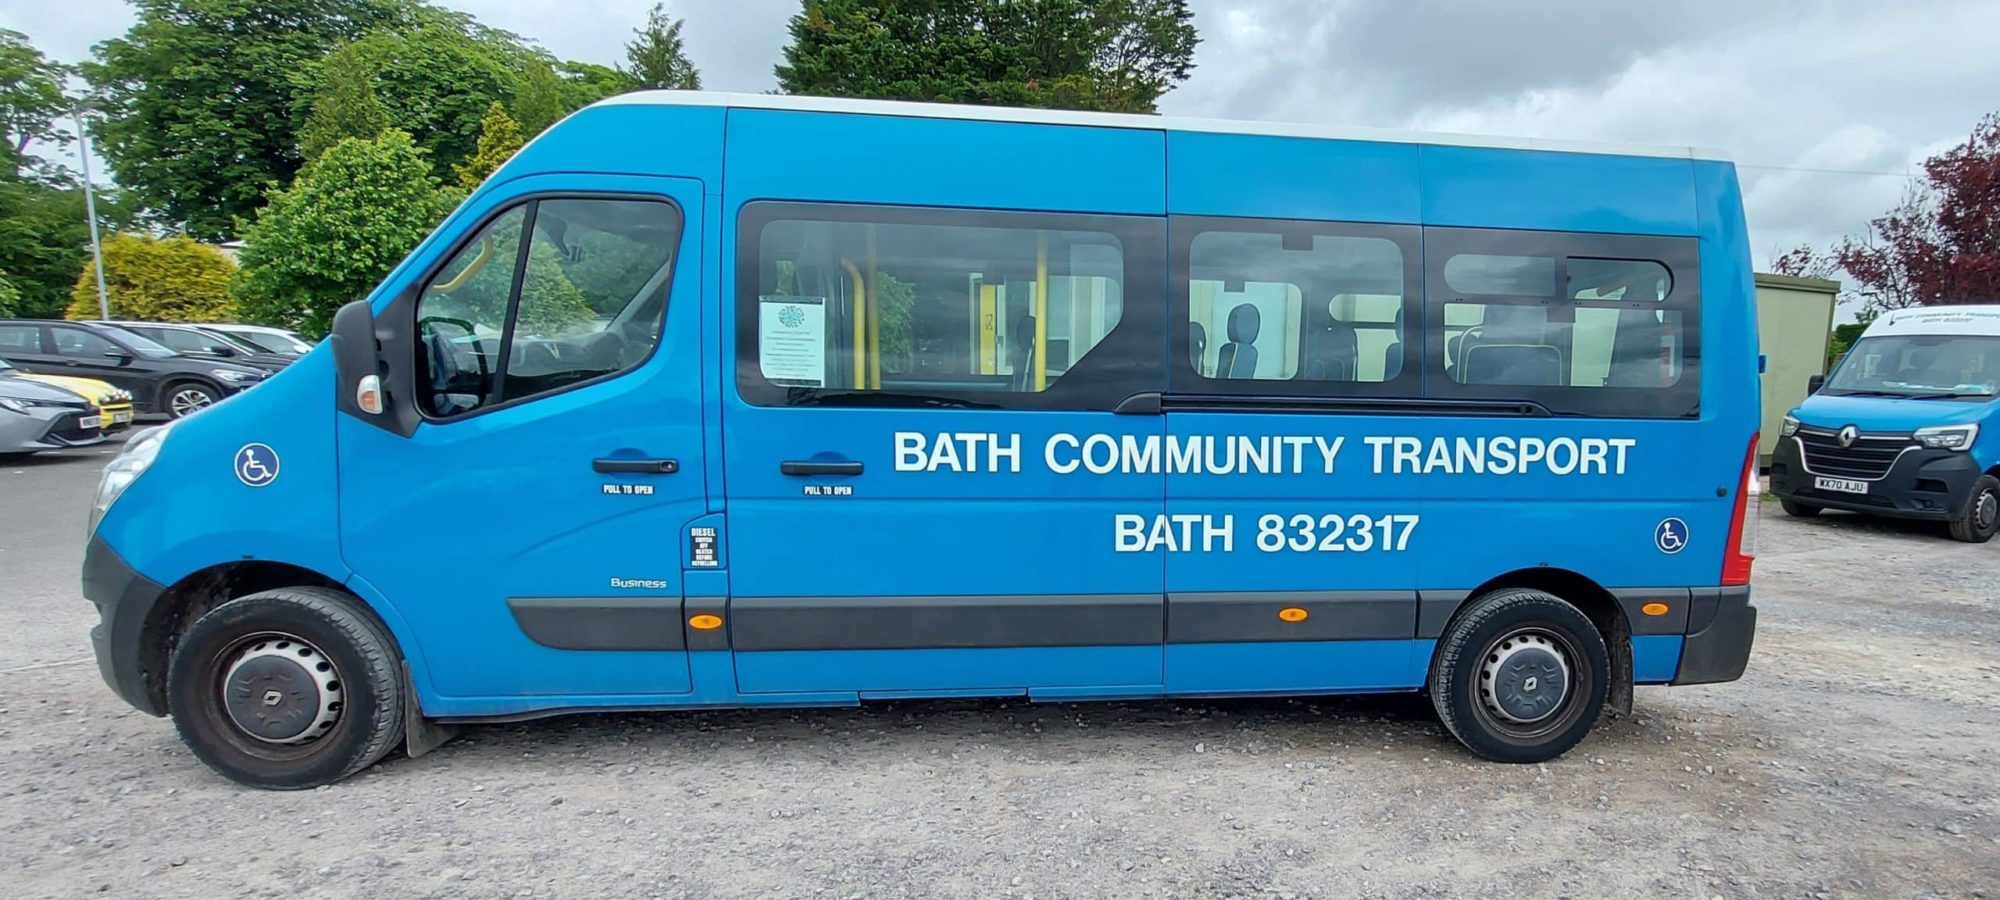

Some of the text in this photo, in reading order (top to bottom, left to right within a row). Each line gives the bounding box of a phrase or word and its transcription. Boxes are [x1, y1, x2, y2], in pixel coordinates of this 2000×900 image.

[894, 432, 1636, 476] BATH COMMUNITY TRANSPORT
[603, 484, 653, 495] PULL TO OPEN
[804, 486, 852, 495] PULL TO OPEN
[1819, 479, 1864, 492] WX70 AJU
[691, 527, 716, 537] DIESEL
[1114, 514, 1419, 552] BATH 832317
[610, 577, 667, 589] Business
